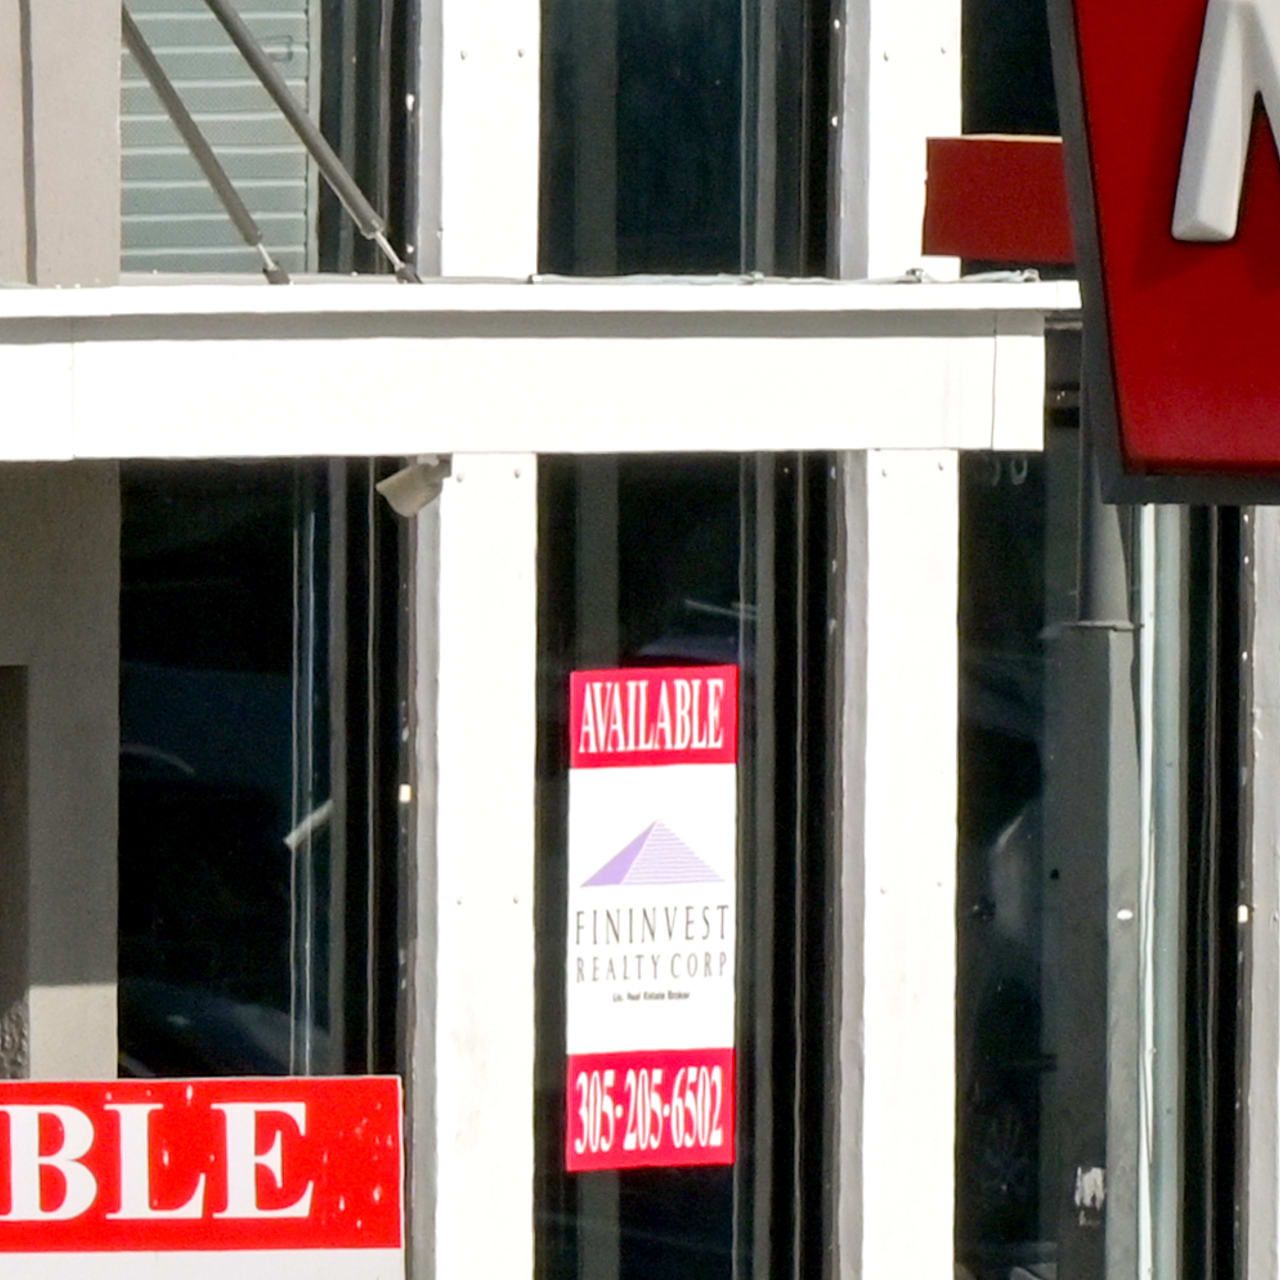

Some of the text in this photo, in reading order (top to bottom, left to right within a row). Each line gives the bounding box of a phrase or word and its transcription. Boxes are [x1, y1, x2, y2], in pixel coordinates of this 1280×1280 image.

[578, 678, 725, 754] AVAILABLE
[575, 904, 730, 945] FININVEST
[575, 951, 728, 983] REALTY CORP
